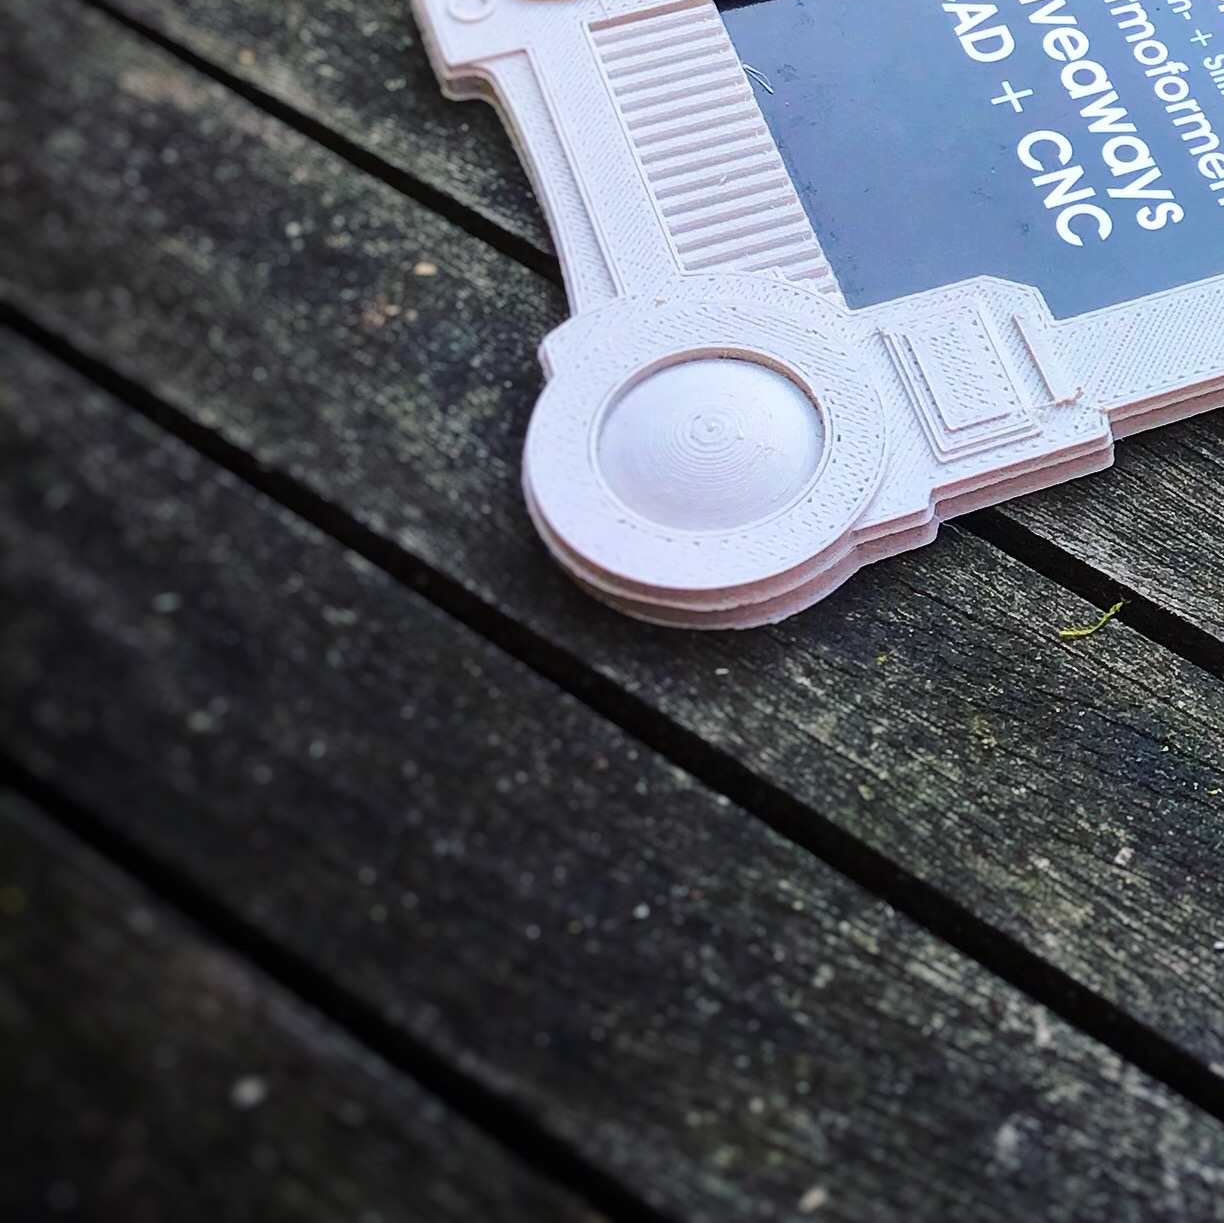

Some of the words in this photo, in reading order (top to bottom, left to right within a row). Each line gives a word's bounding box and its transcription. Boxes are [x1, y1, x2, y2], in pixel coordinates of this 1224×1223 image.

[1190, 29, 1212, 46] +
[991, 81, 1033, 112] +
[1017, 131, 1112, 246] CNC
